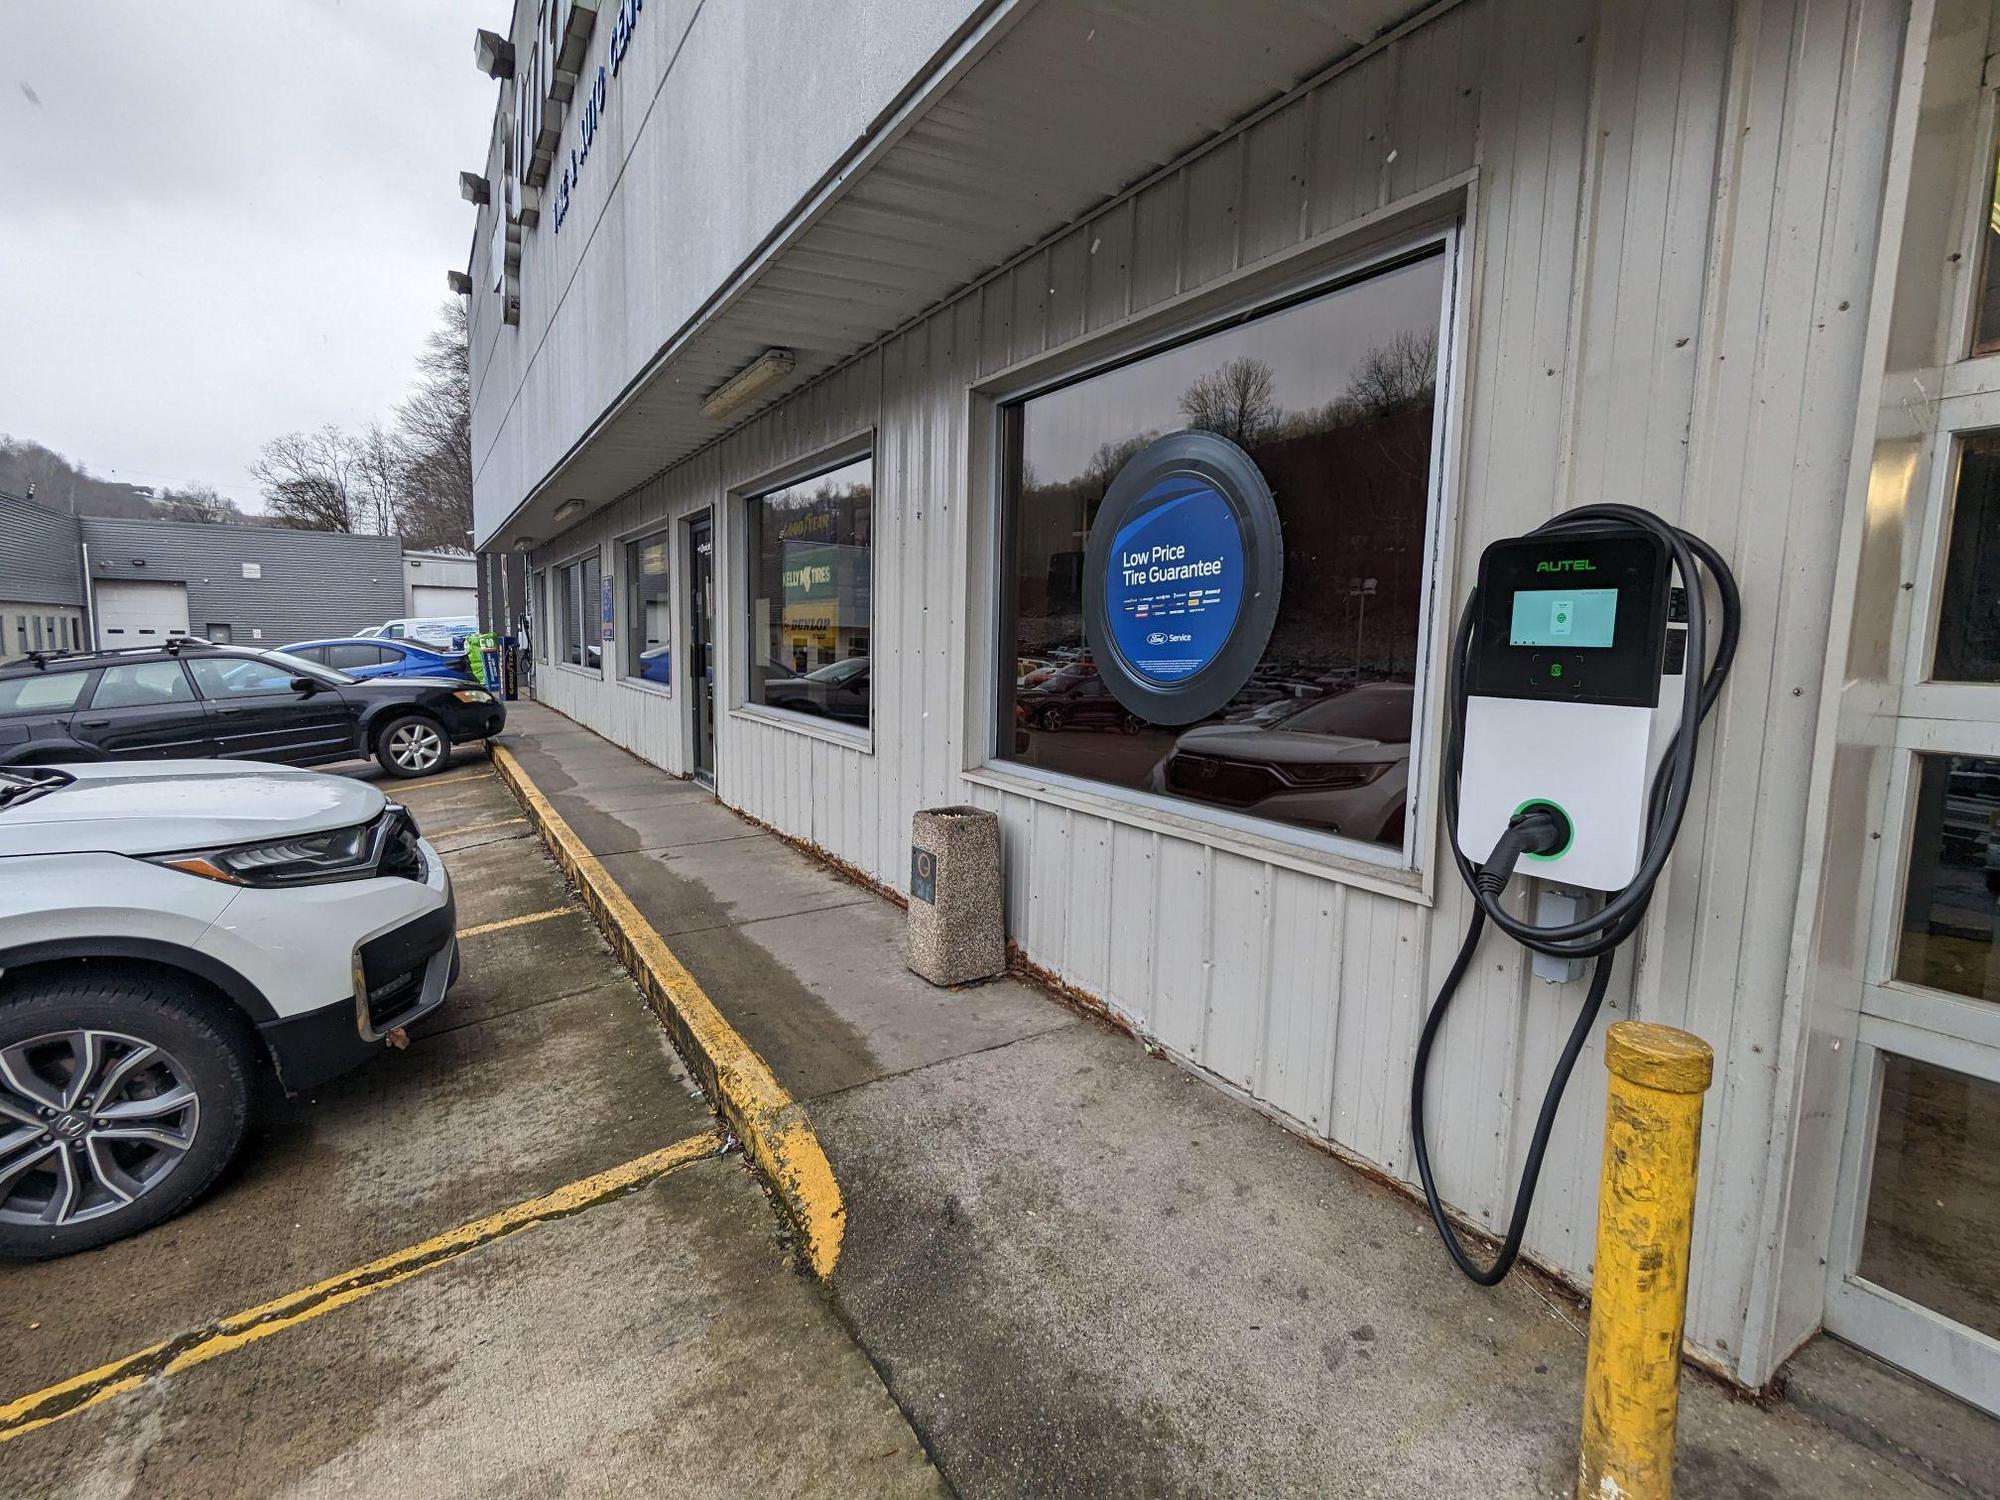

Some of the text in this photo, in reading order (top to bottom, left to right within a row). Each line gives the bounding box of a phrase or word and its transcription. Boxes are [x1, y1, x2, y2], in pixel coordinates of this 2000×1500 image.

[609, 0, 643, 79] CEN
[1123, 544, 1185, 568] Low Price
[1536, 559, 1597, 572] AUTEL
[1123, 569, 1146, 586] Tire
[1148, 633, 1192, 644] Ford Service
